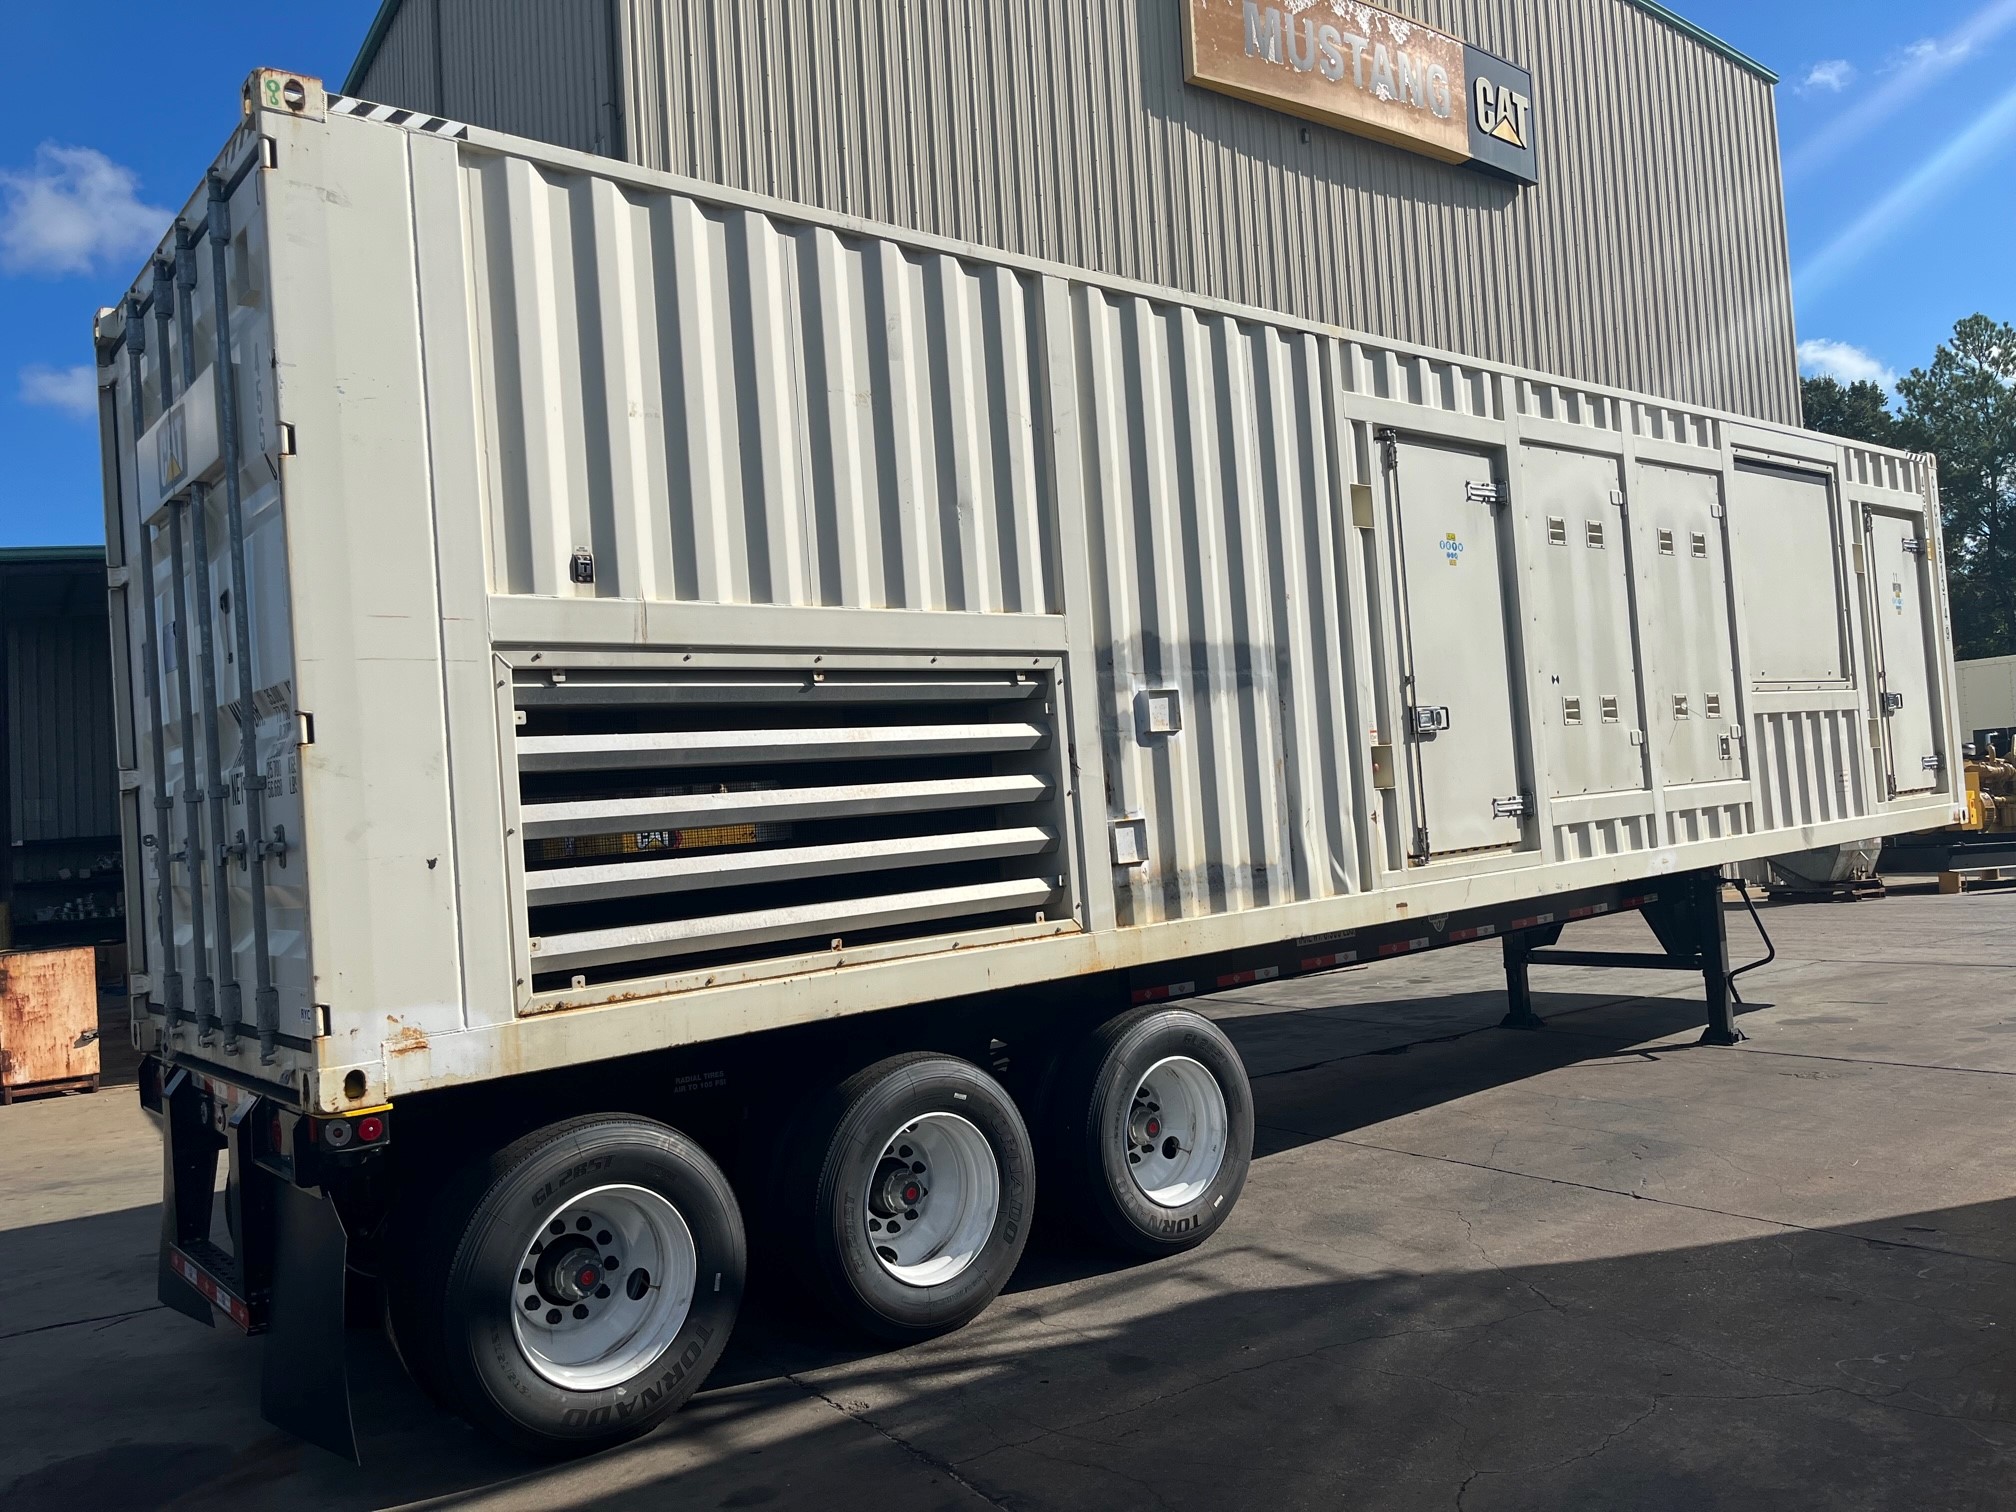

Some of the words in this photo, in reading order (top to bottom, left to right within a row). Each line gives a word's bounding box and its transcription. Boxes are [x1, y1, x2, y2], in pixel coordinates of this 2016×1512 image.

[1242, 1, 1453, 119] MUSTANG
[1472, 76, 1530, 150] CAT
[561, 1323, 715, 1428] TORNADO
